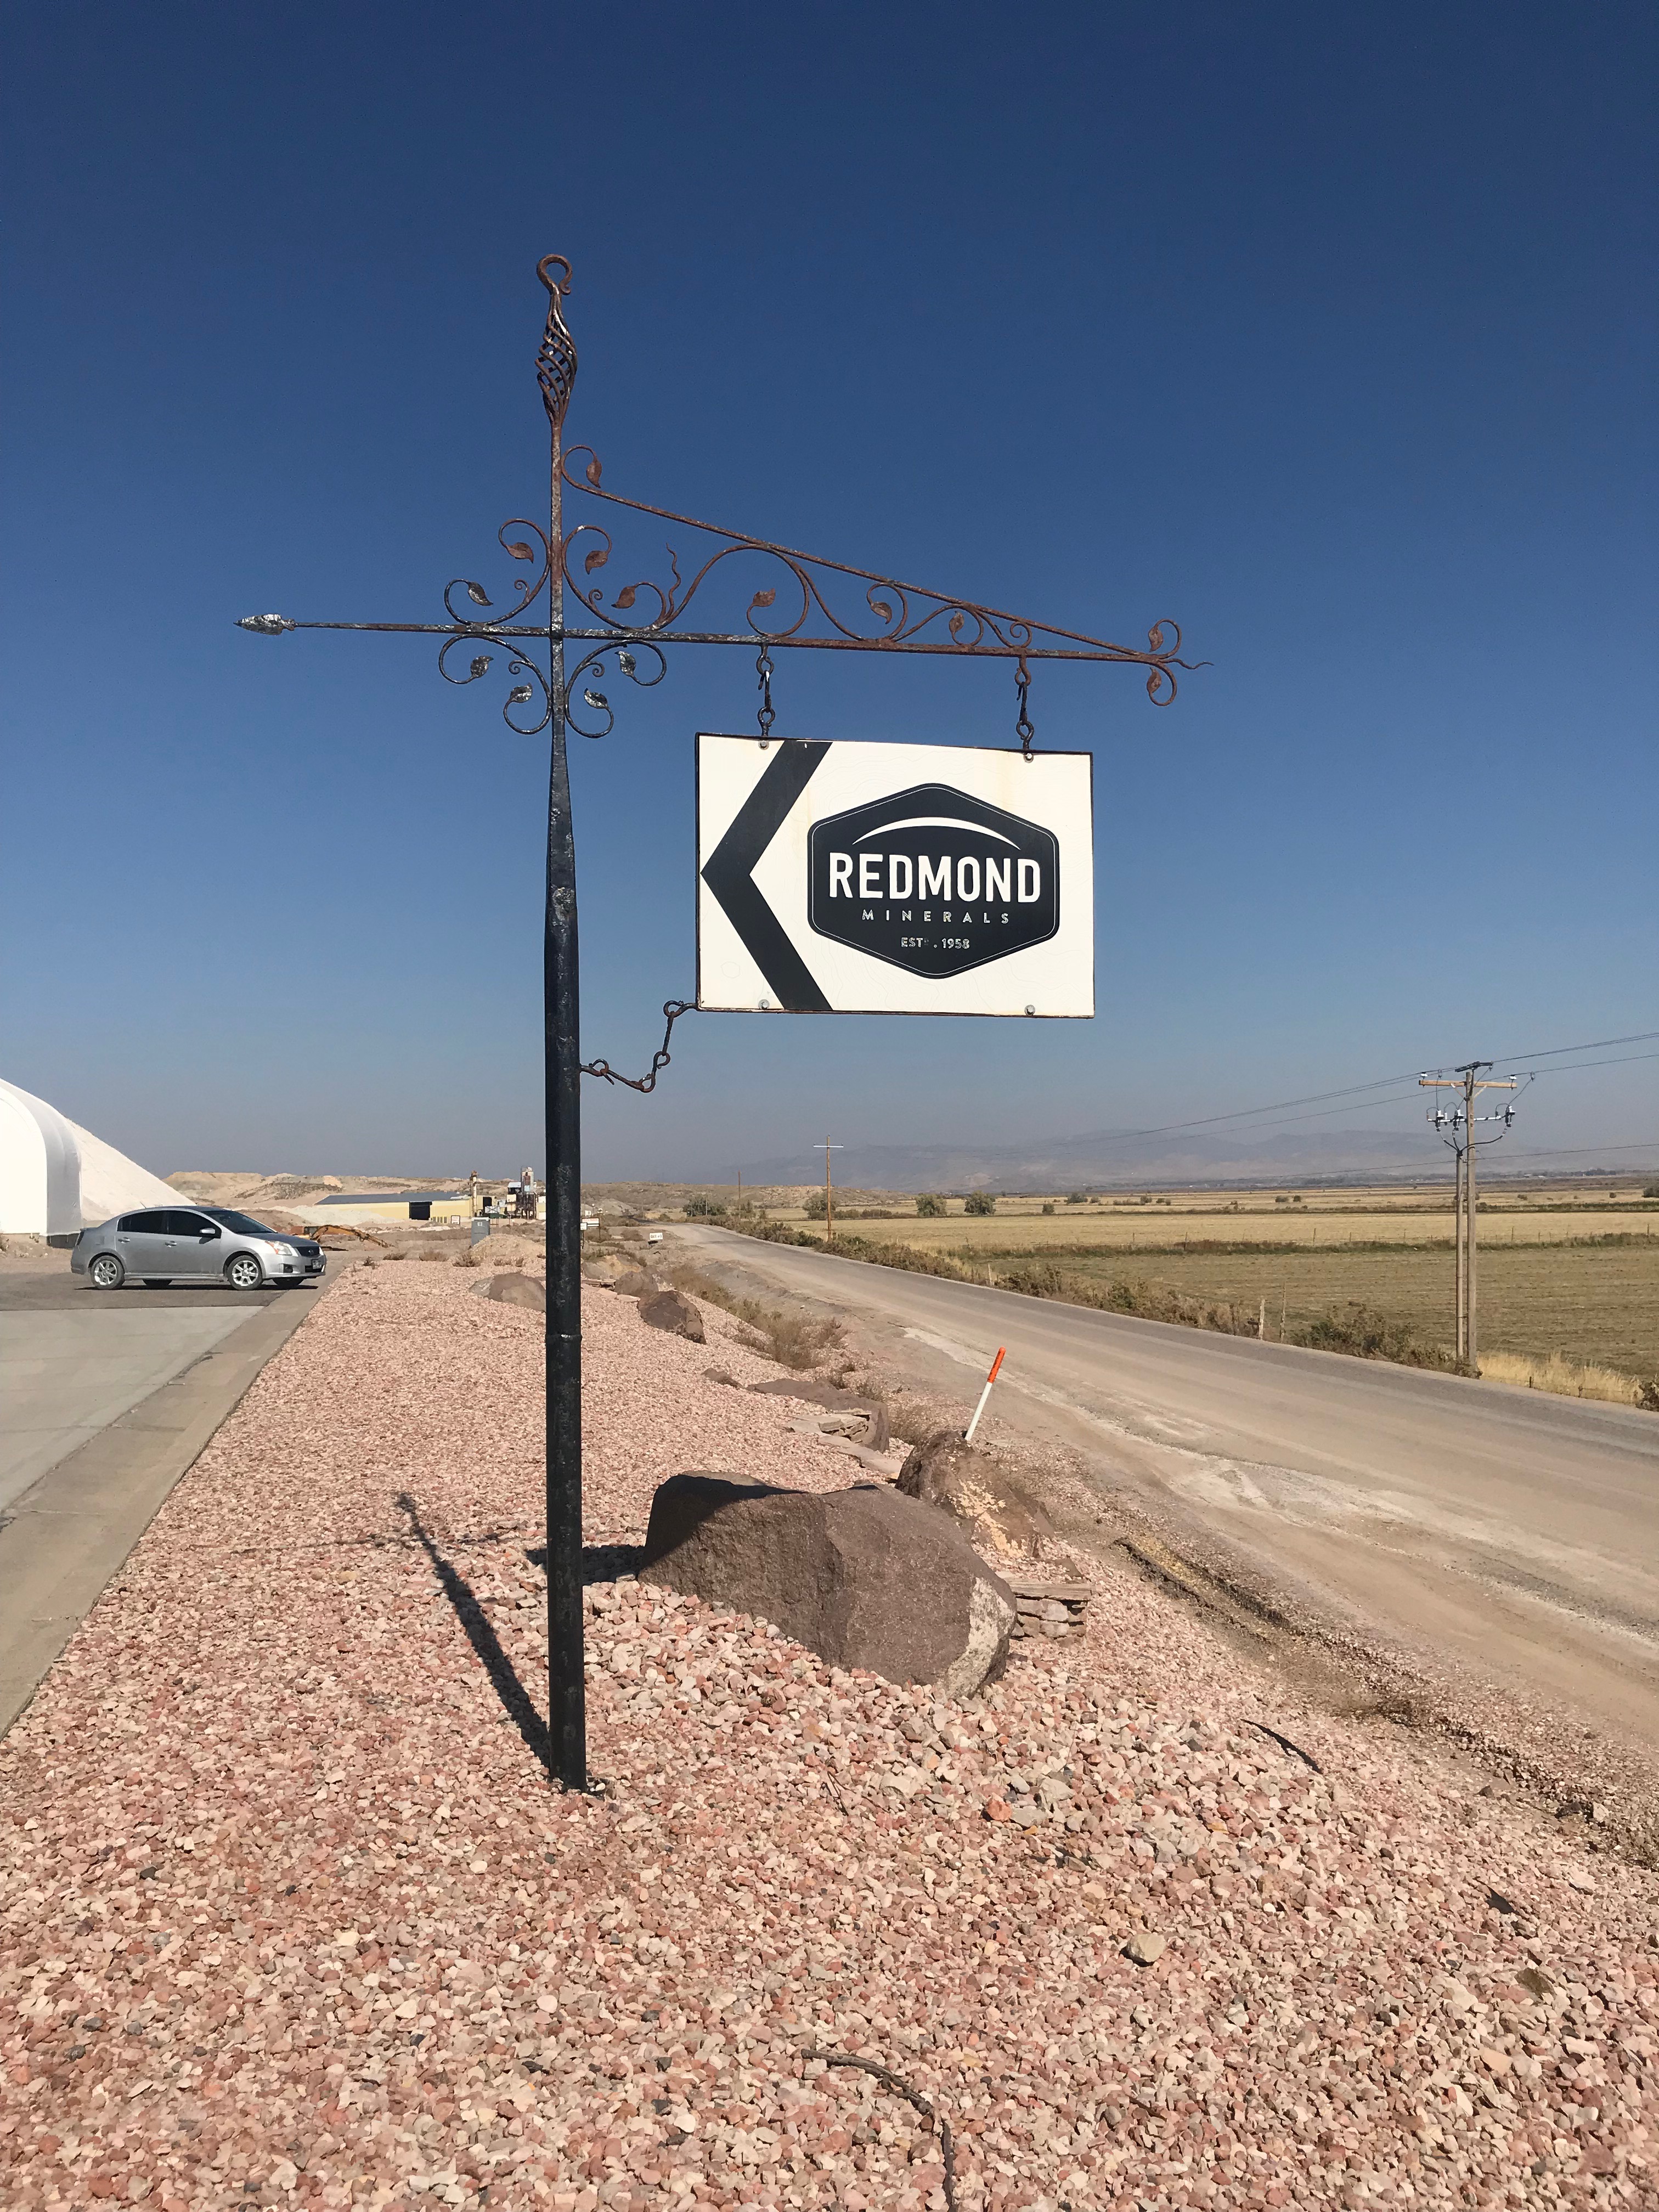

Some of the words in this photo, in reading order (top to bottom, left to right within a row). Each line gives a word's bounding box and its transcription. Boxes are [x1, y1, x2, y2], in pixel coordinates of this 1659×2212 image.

[829, 852, 1041, 903] REDMOND
[862, 909, 1009, 924] MINERALS
[941, 938, 970, 949] 1958
